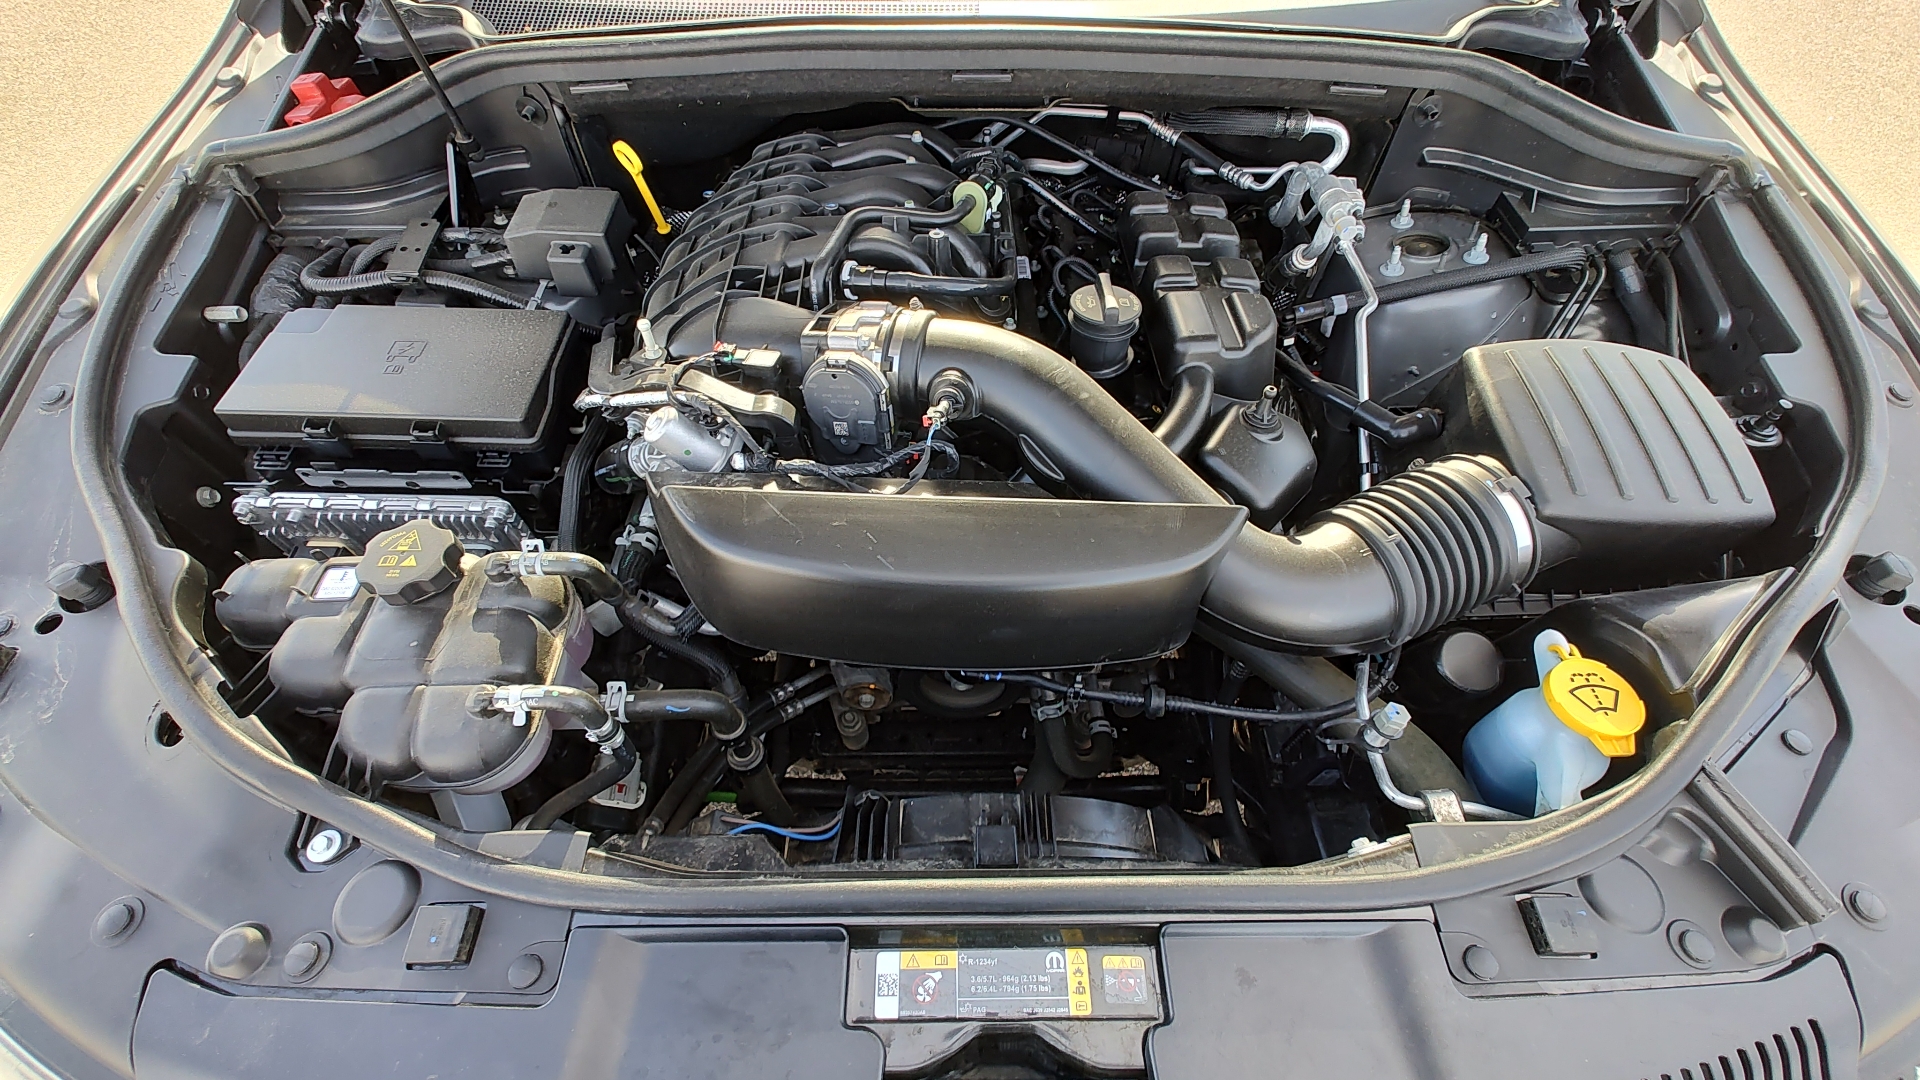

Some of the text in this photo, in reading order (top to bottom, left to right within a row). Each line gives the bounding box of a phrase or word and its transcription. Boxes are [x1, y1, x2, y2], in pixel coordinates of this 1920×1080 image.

[968, 957, 998, 967] R-1234yf
[970, 975, 997, 983] 3.6/5.7L
[1002, 975, 1019, 984] 964g
[1020, 974, 1037, 983] (2.13
[1037, 974, 1051, 983] lbs)
[970, 985, 998, 993] 6.2/6.4L
[1002, 985, 1020, 994] 794g
[1021, 985, 1037, 993] (1.75
[1038, 984, 1051, 993] lbs)
